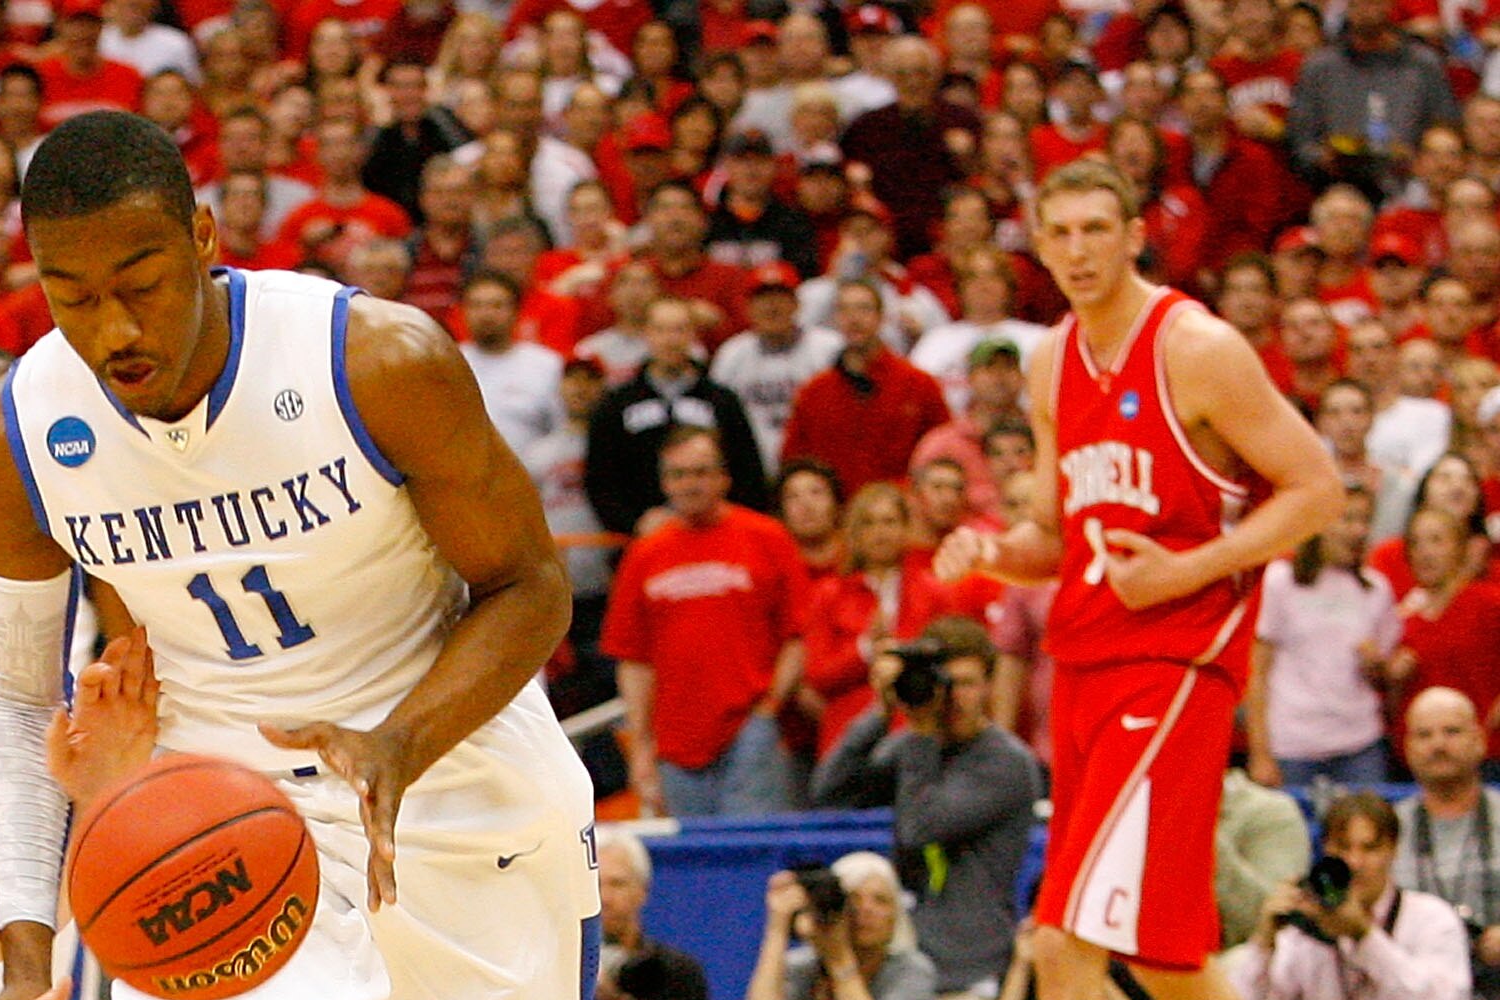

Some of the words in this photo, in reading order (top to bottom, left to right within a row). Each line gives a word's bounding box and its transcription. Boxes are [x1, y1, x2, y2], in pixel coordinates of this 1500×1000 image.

[54, 440, 89, 458] NCAA
[65, 457, 362, 566] KENTUCKY
[187, 565, 316, 661] 11
[137, 857, 253, 947] NCAA
